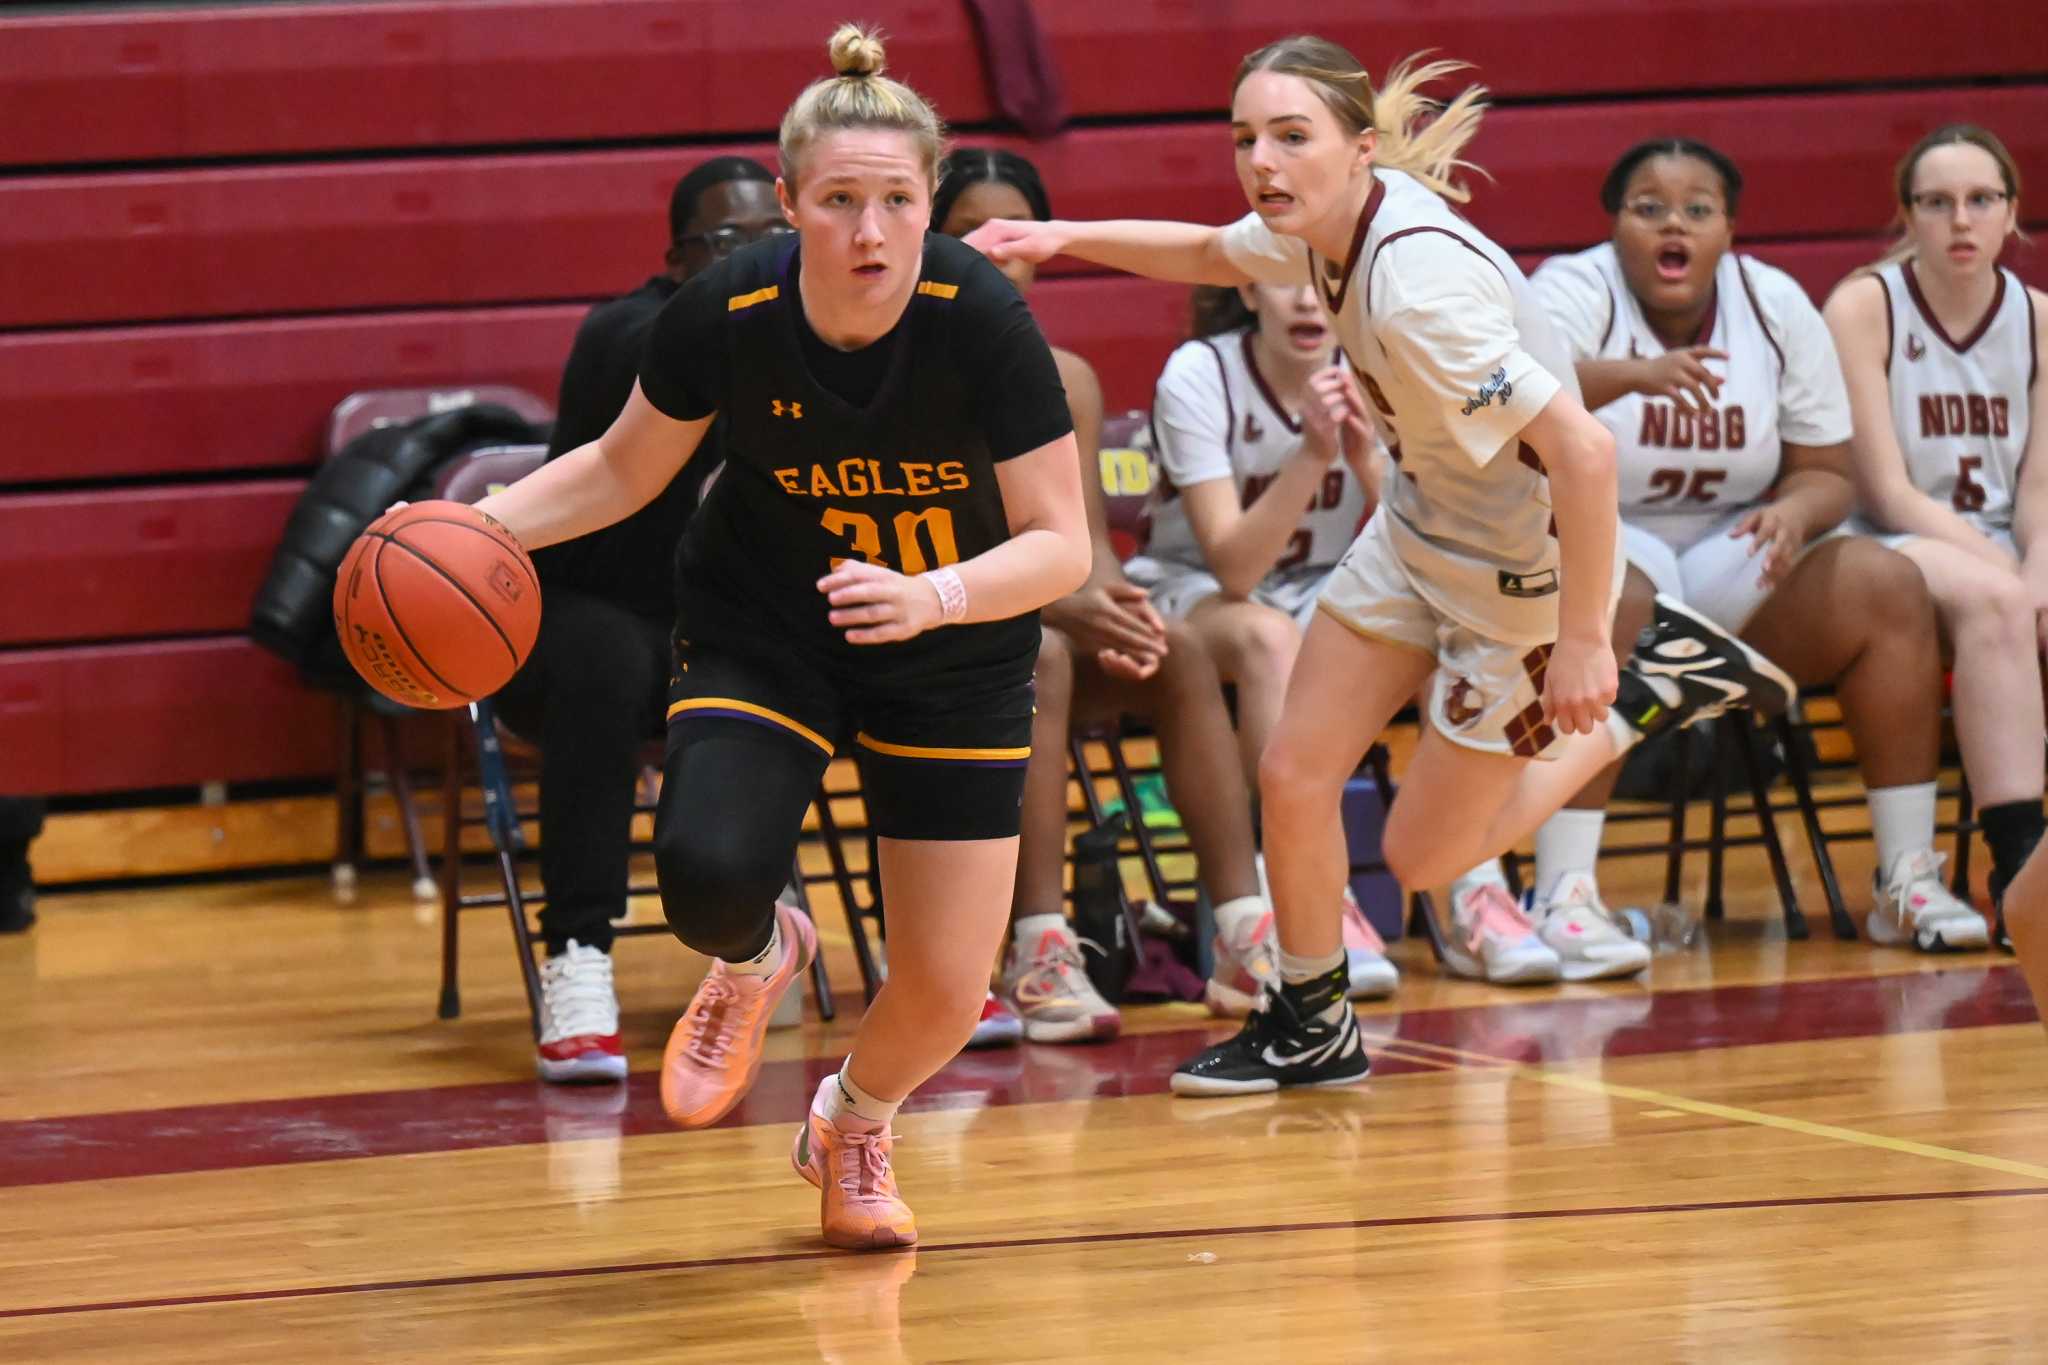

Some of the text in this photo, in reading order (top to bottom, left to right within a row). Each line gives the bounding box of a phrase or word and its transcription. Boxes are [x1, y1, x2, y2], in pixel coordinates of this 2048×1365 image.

[1639, 402, 1746, 450] NDBG
[1918, 394, 2009, 438] NDBG
[774, 457, 970, 497] EAGLES
[1640, 467, 1728, 503] 25
[819, 506, 961, 577] 30
